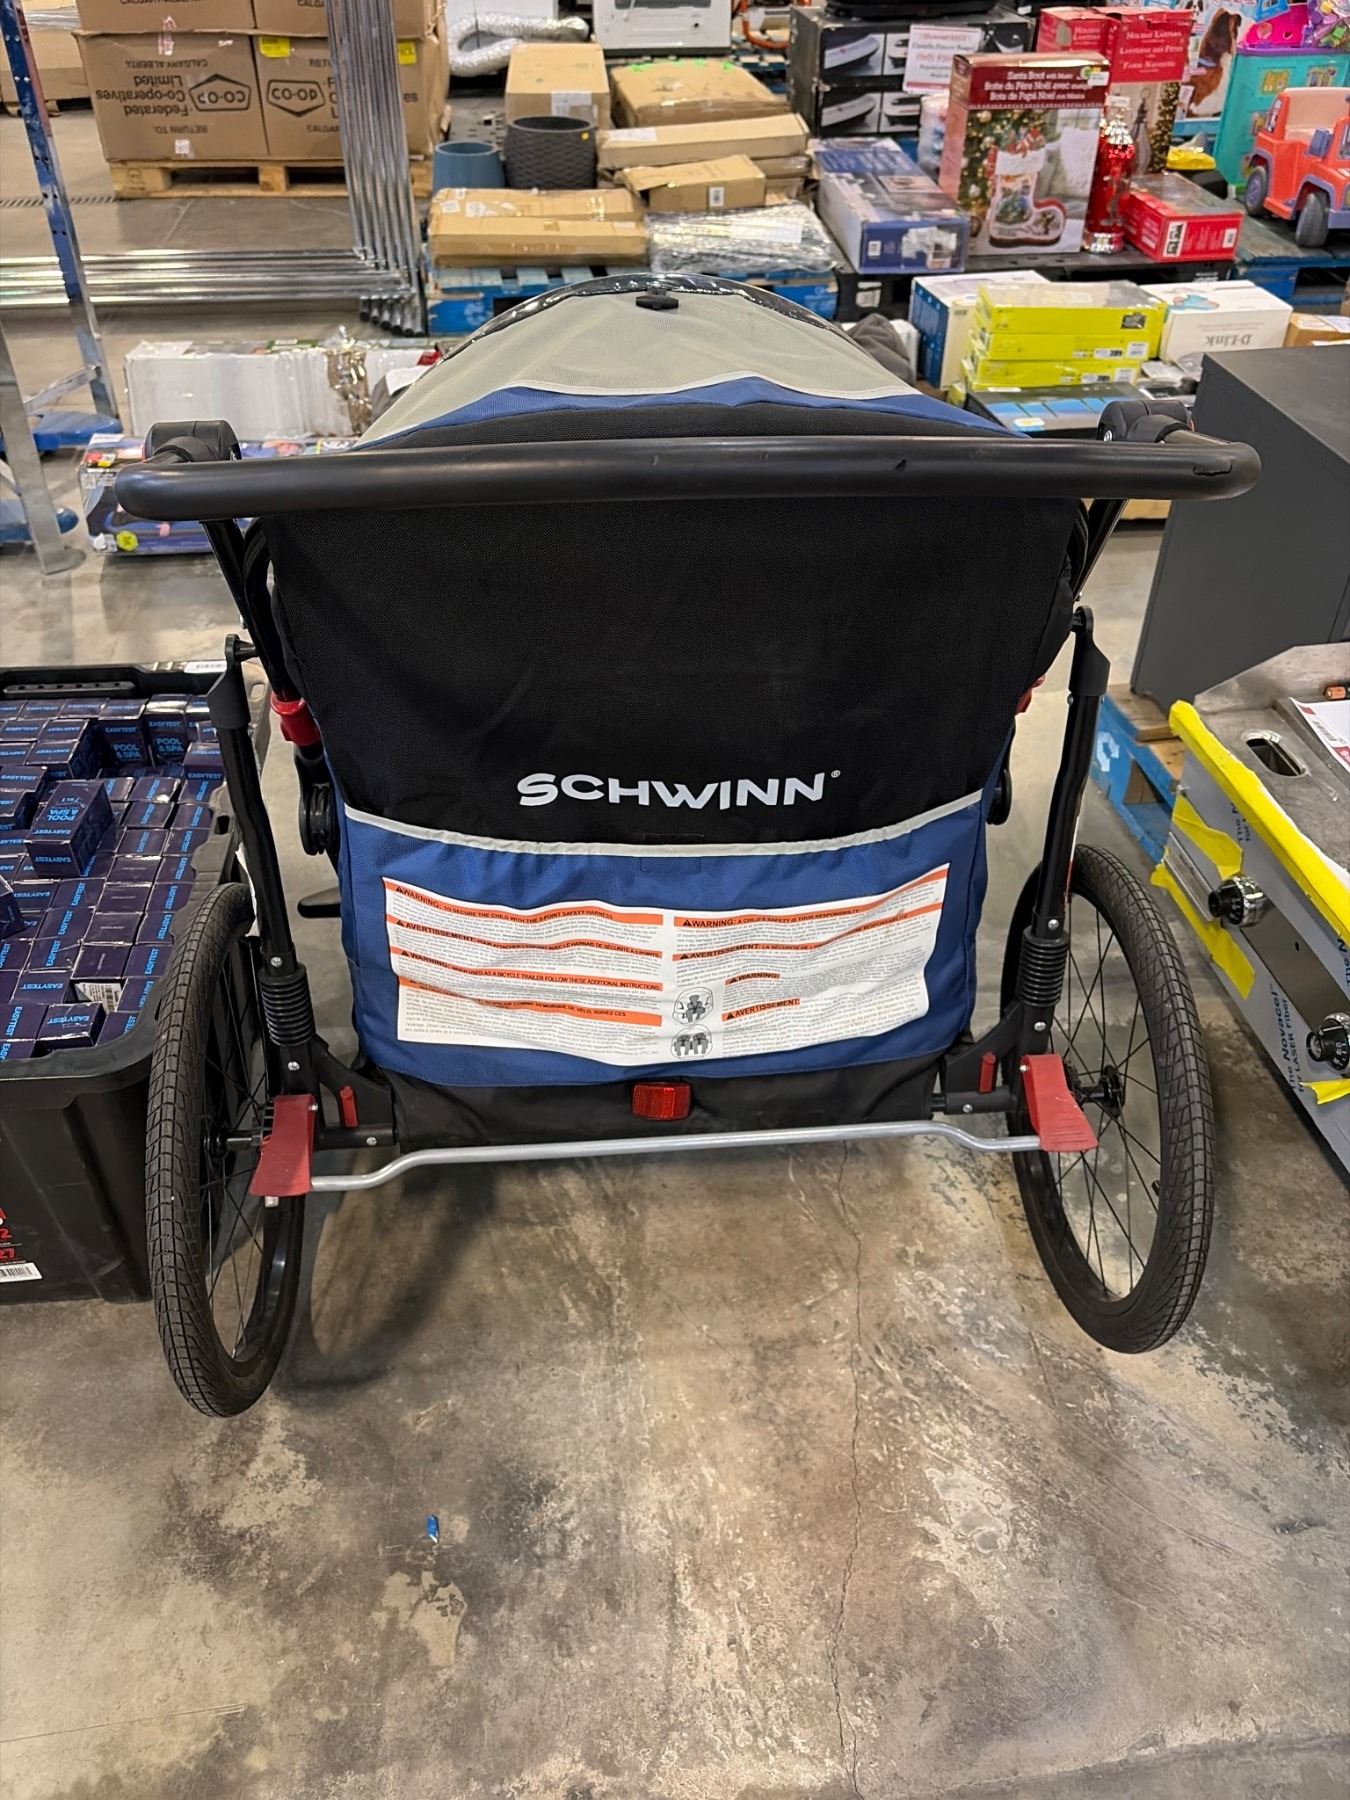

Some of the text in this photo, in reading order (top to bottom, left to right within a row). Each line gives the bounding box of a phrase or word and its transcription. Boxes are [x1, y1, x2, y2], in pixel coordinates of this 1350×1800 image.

[134, 75, 183, 87] Limited
[95, 89, 185, 102] Co-operatives
[124, 104, 189, 117] Federated
[1205, 334, 1253, 345] D-Link
[71, 882, 86, 906] EASYTEST
[453, 907, 476, 917] SECURE
[563, 909, 585, 917] SAFETY
[58, 910, 73, 935] EASYTEST
[692, 919, 737, 928] WARNING:
[46, 940, 61, 966] EASYTEST
[145, 948, 159, 975] EASYTEST
[545, 975, 568, 983] FOLLOW
[588, 978, 618, 987] ADDITIONAL
[5, 1006, 22, 1036] EASYTEST
[47, 1015, 90, 1024] EASYTEST
[1271, 990, 1290, 1062] Novacel
[1287, 1032, 1301, 1074] LASER
